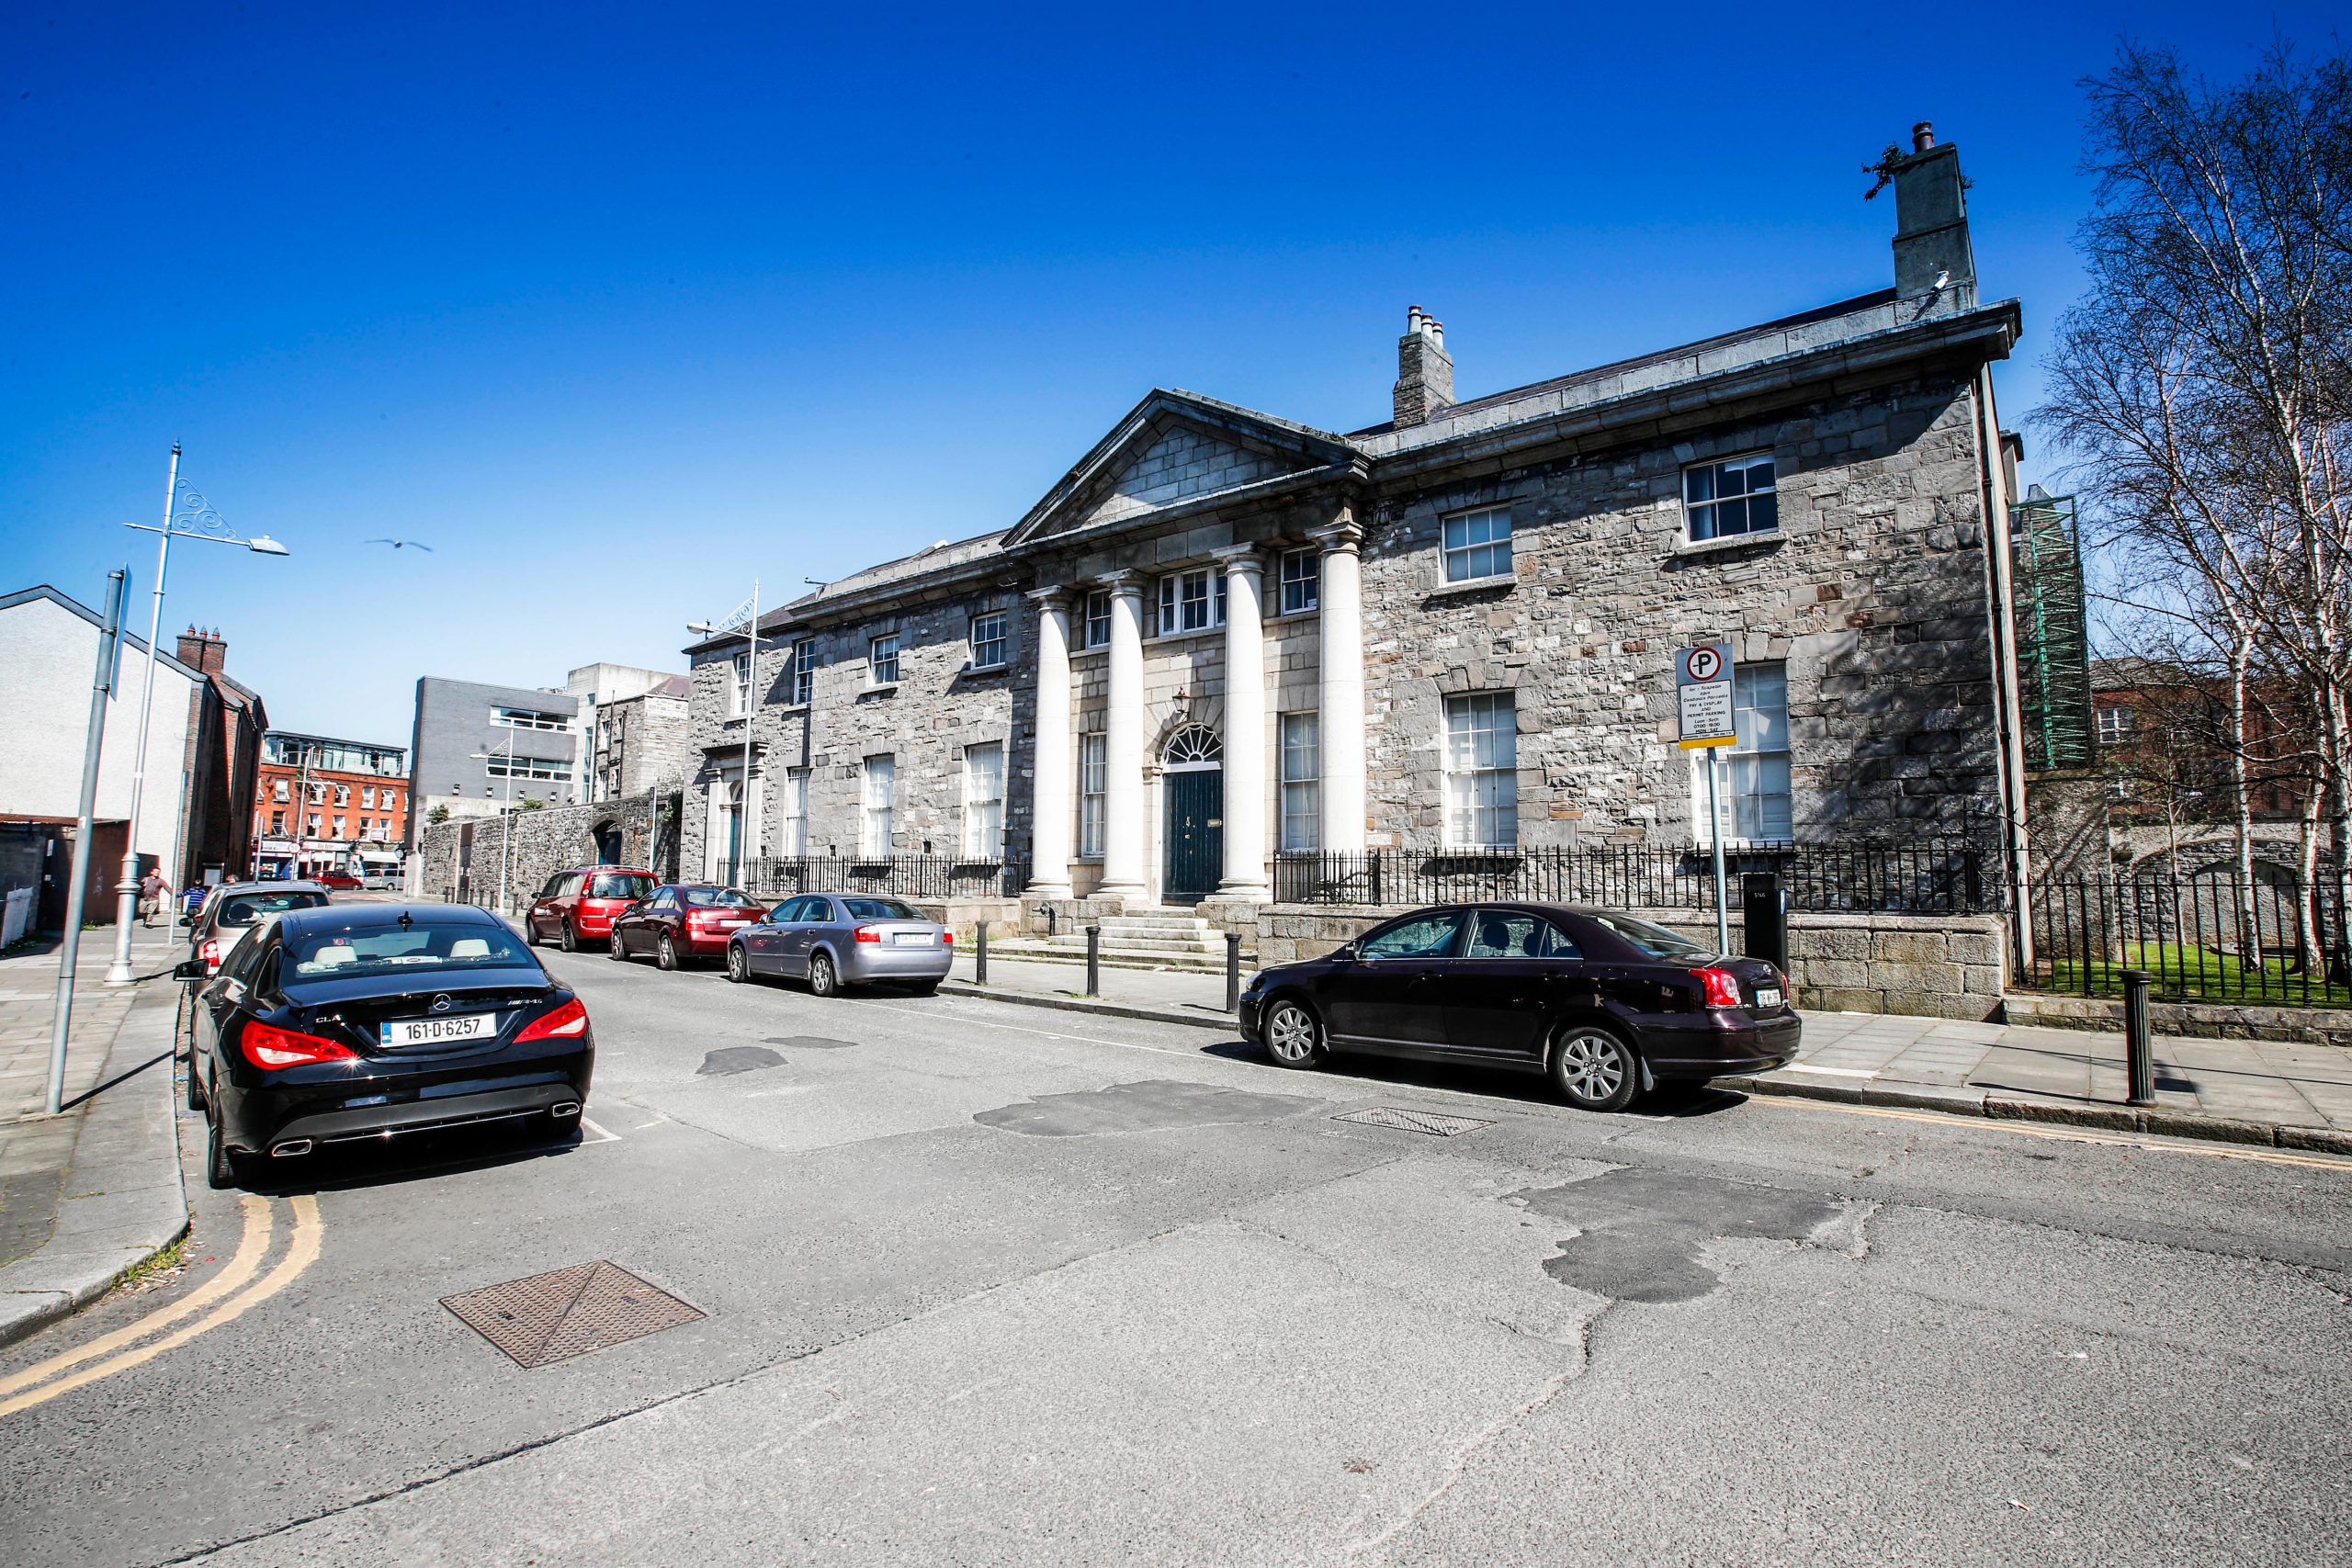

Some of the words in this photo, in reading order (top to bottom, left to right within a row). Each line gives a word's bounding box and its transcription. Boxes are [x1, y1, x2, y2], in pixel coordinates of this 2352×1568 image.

[1698, 653, 1712, 674] P
[315, 1014, 341, 1023] CLA
[406, 1019, 481, 1040] 161-D-6257
